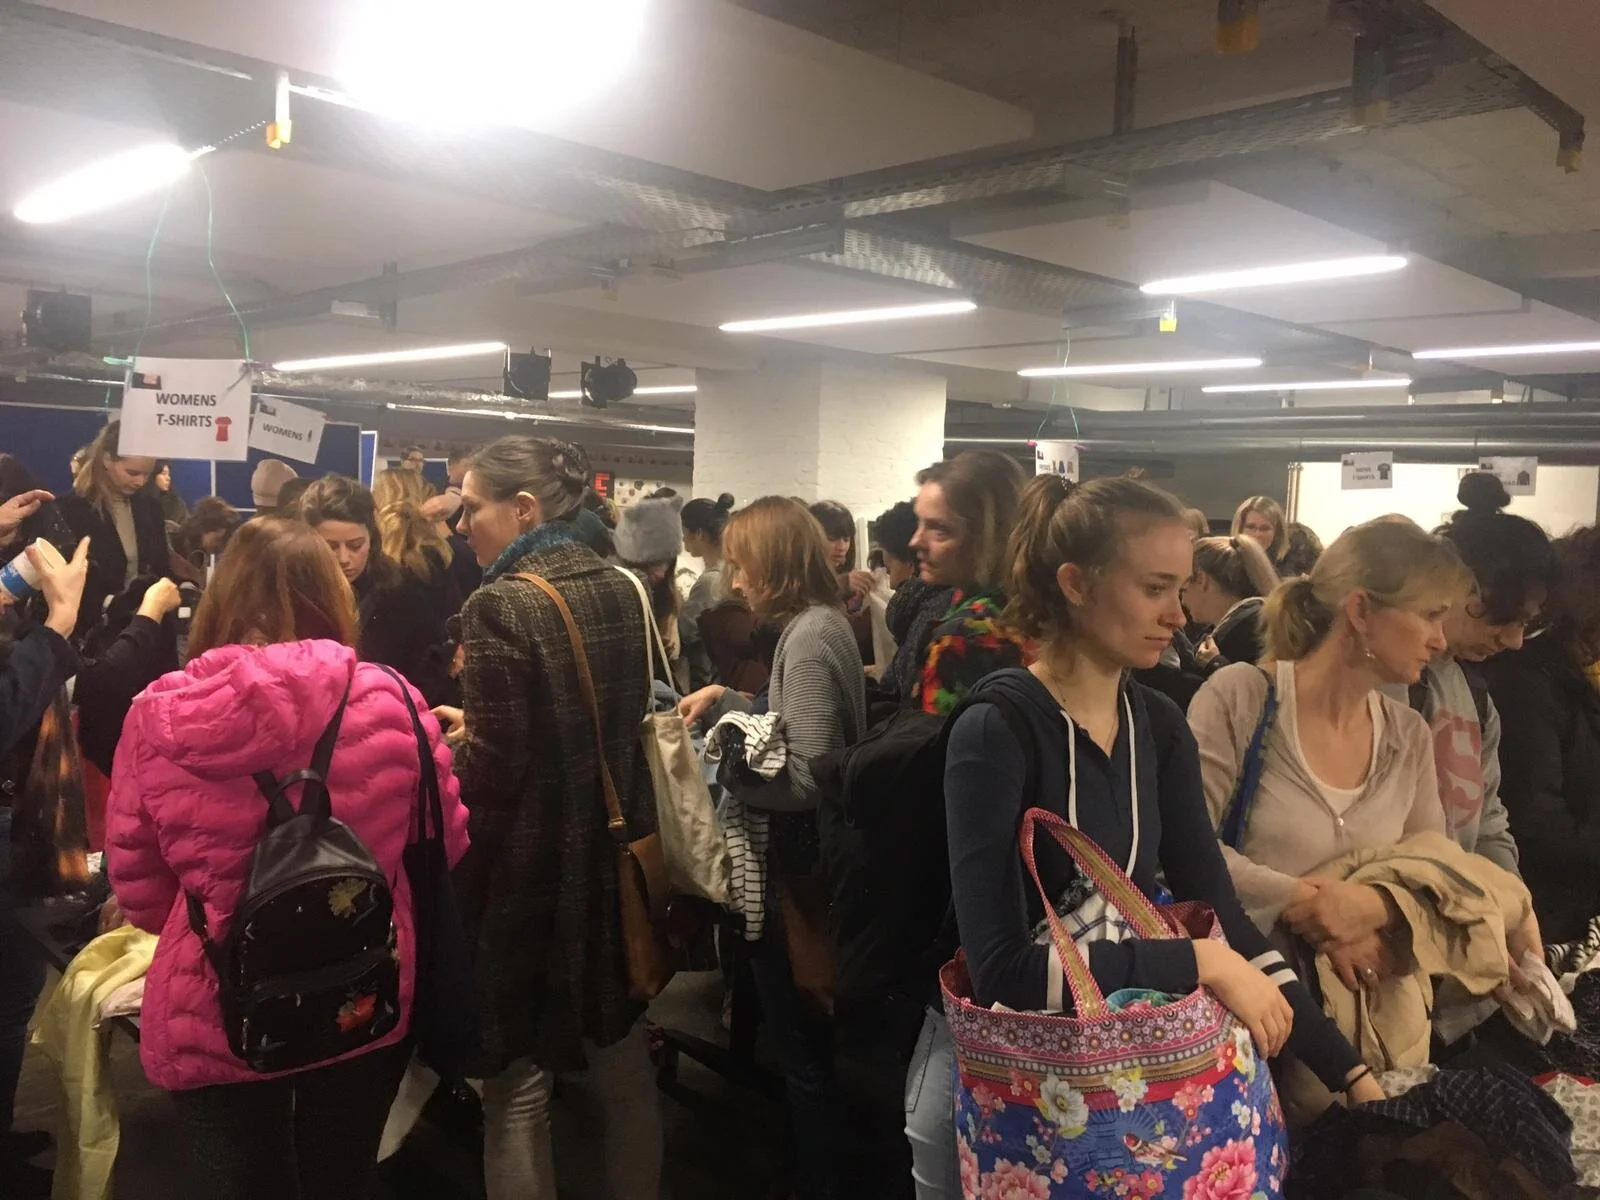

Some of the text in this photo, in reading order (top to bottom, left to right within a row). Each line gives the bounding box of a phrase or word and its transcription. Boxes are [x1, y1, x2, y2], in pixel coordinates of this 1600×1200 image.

[155, 392, 217, 407] WOMENS
[155, 413, 213, 428] T-SHIRTS
[262, 422, 304, 441] WOMENS
